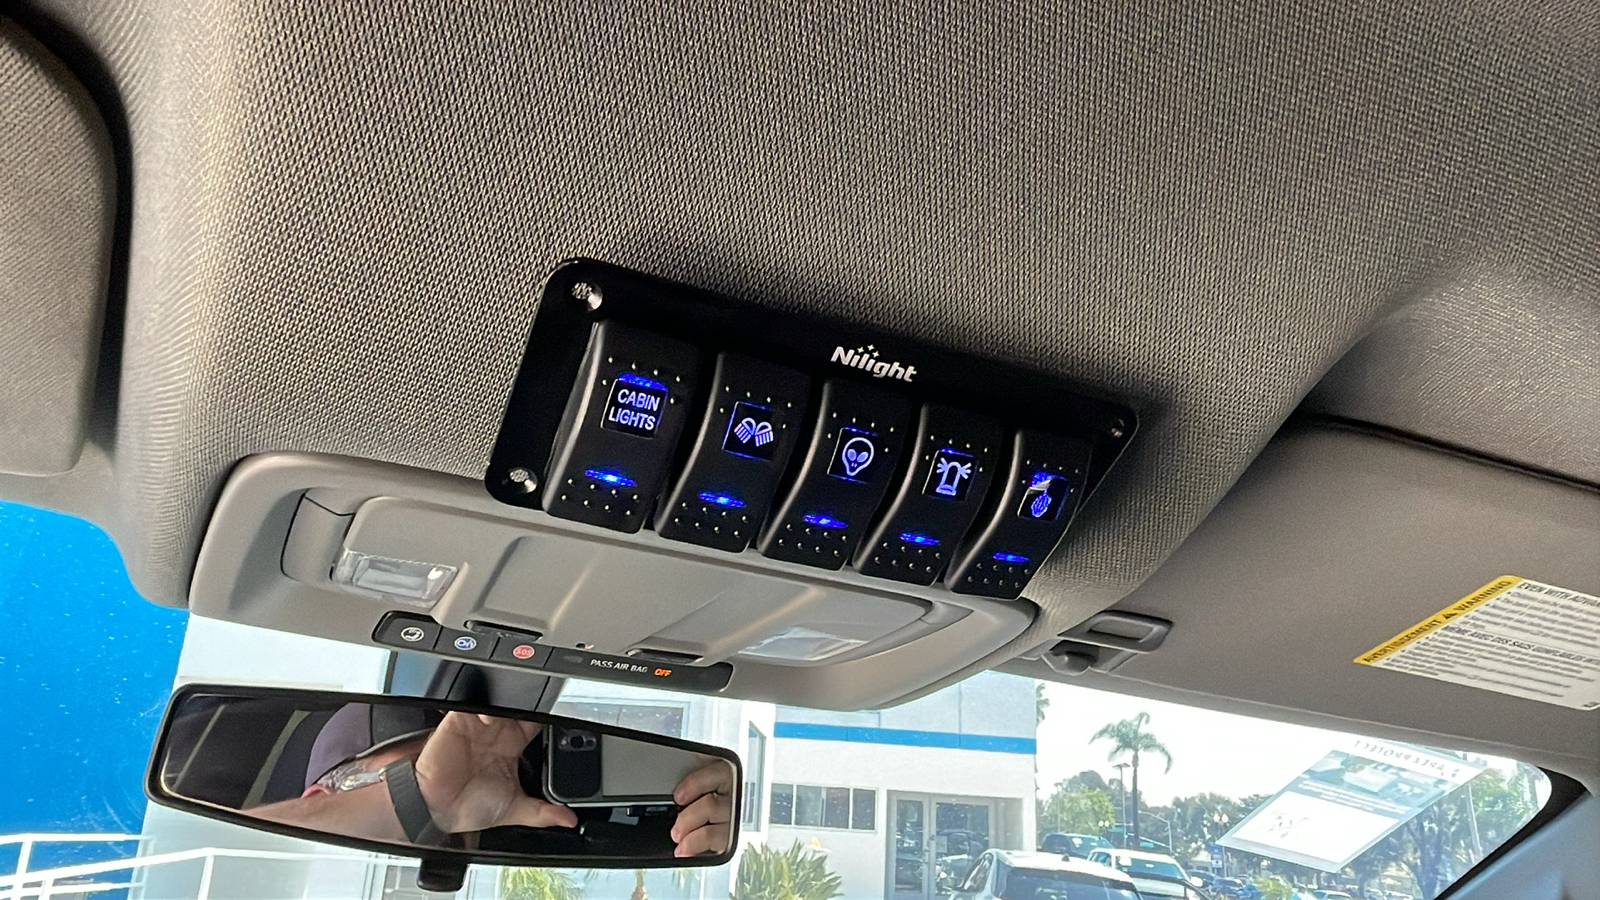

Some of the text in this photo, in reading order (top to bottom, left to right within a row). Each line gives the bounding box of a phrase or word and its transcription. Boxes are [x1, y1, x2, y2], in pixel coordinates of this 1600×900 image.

[830, 345, 917, 383] Nilight
[617, 388, 660, 412] CABIN
[608, 406, 656, 431] LIGHTS
[1453, 580, 1512, 612] WARNING
[1517, 582, 1546, 594] EVEN
[1544, 588, 1573, 599] WITH
[515, 647, 532, 656] SOS
[590, 659, 672, 677] PASS AIR BAG OFF
